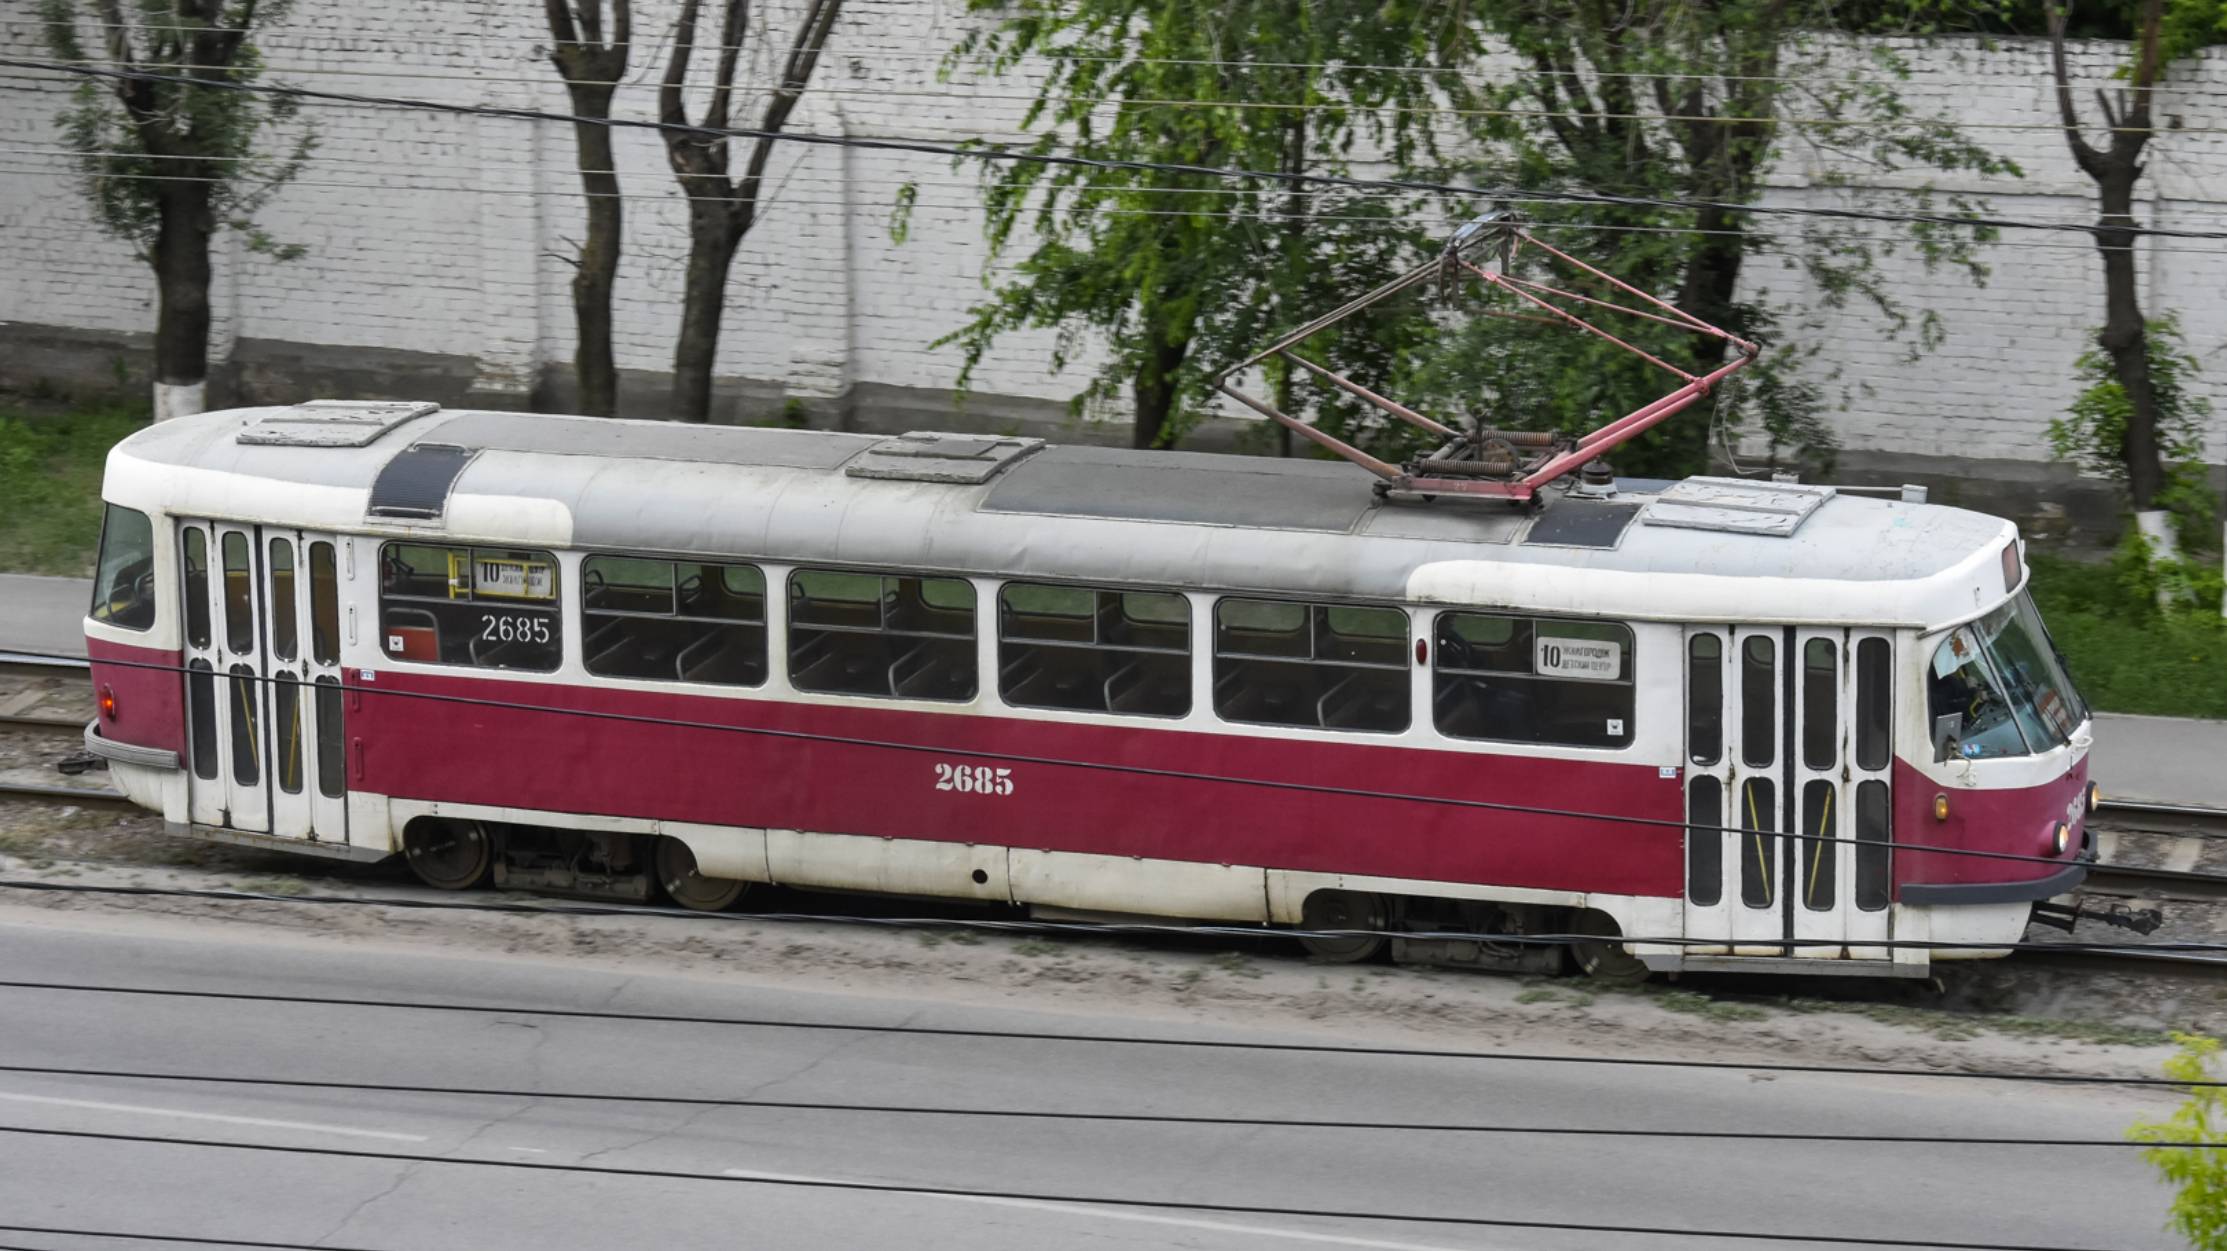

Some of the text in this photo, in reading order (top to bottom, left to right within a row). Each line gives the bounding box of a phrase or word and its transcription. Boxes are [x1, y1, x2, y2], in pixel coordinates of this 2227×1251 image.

[481, 562, 500, 582] 10
[482, 615, 549, 643] 2685
[1541, 644, 1561, 668] 10
[935, 763, 1014, 795] 2685
